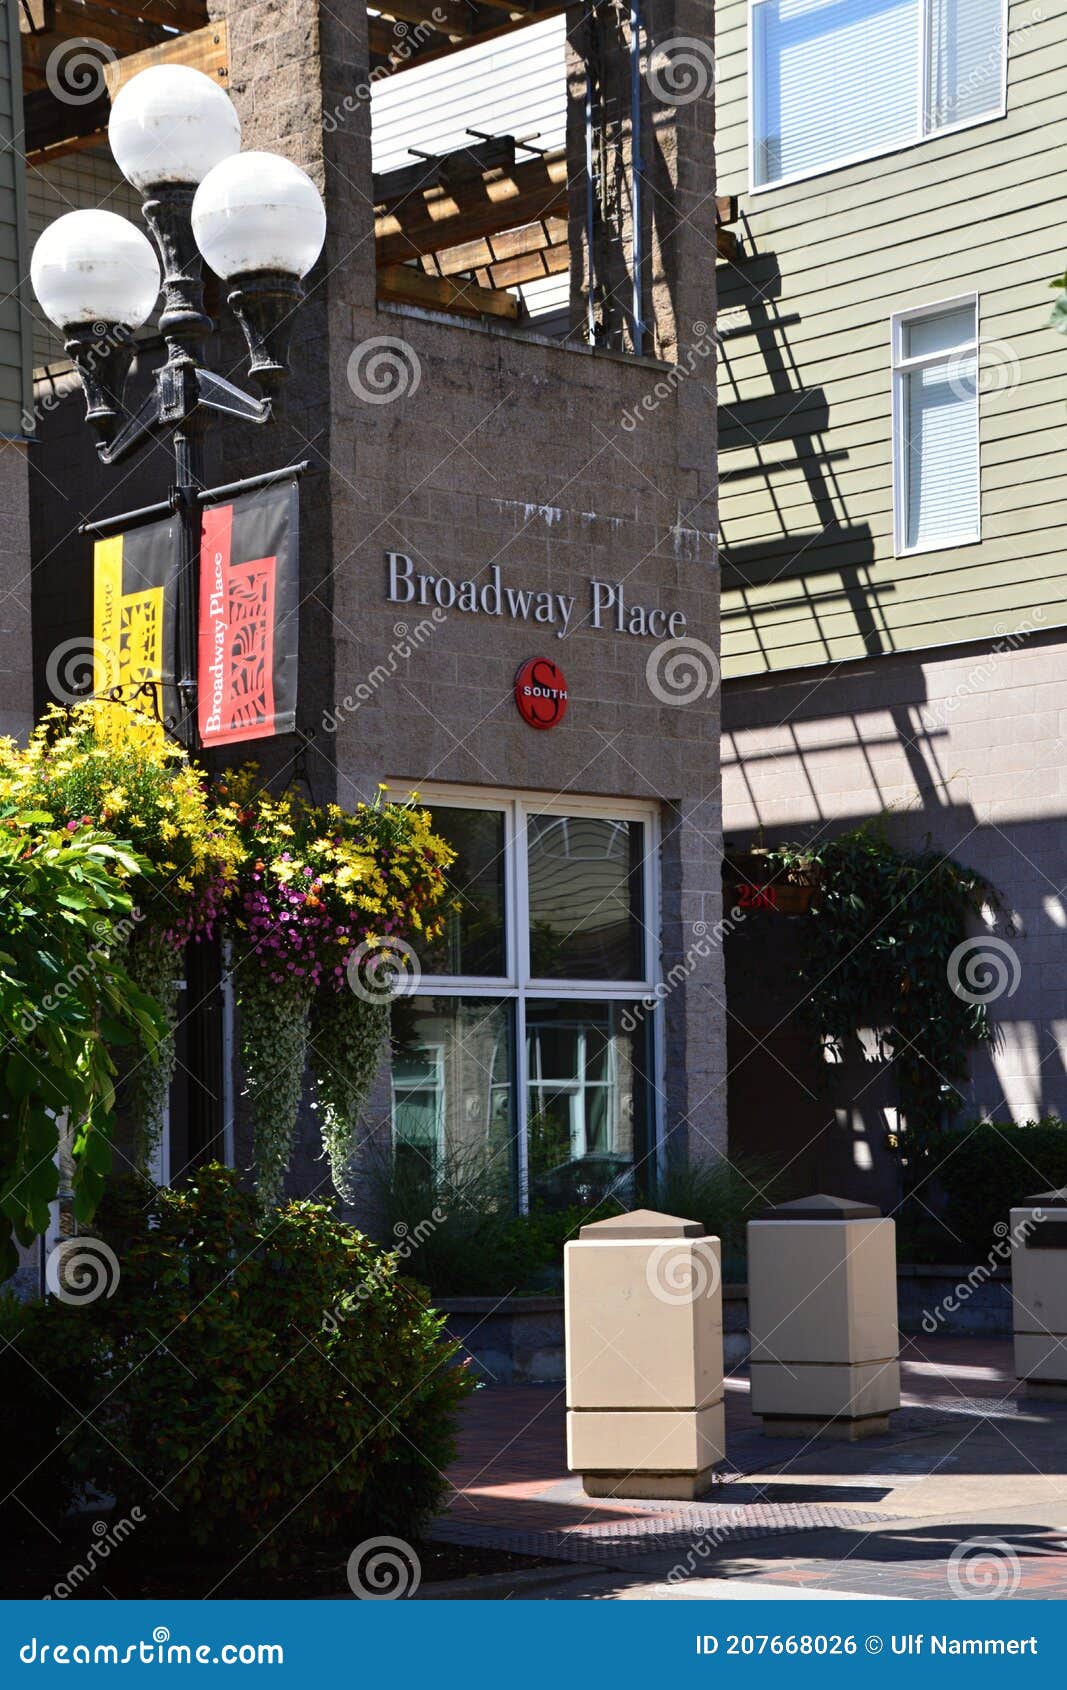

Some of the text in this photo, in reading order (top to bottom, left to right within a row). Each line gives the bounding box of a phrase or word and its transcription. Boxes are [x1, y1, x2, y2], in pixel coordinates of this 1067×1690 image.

[102, 584, 113, 641] Place
[385, 551, 688, 640] Broadway Place
[205, 552, 228, 732] Broadway Place
[523, 685, 568, 700] SOUTH
